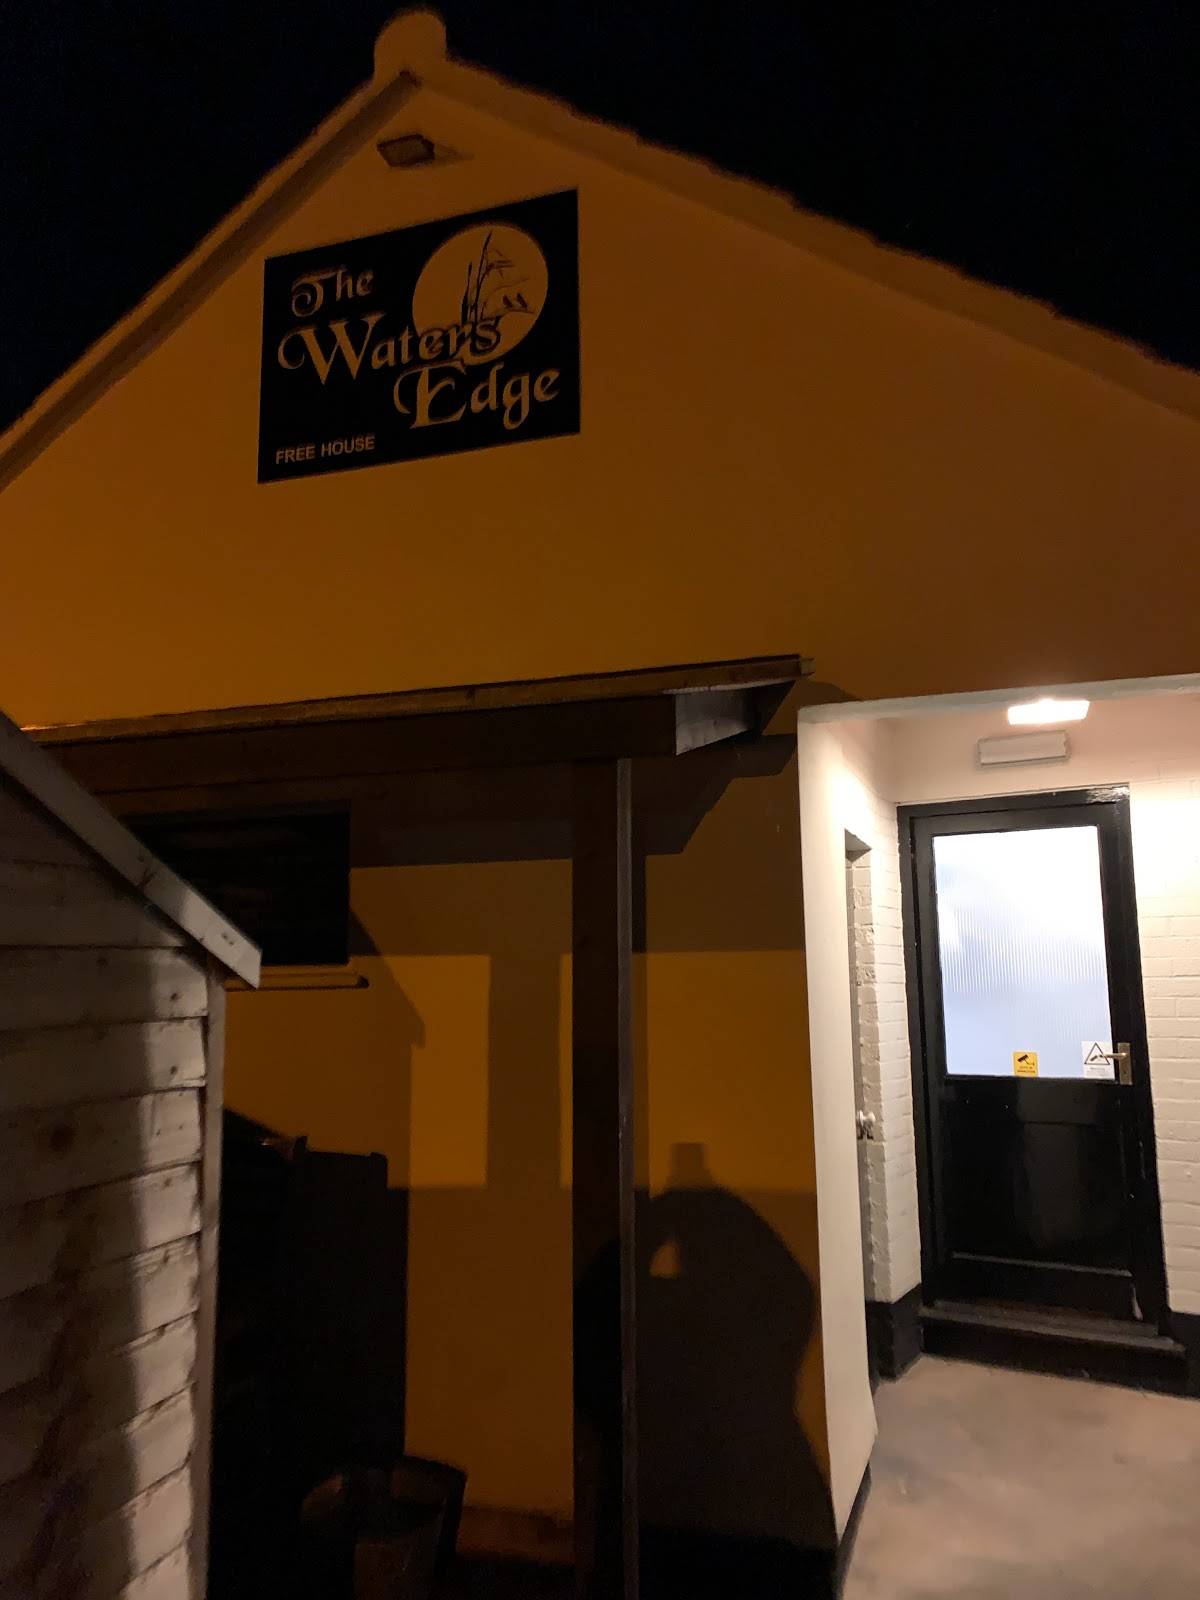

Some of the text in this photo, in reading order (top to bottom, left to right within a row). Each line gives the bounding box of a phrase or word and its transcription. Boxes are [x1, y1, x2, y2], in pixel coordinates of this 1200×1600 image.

[291, 265, 374, 318] The
[277, 313, 501, 385] Waters
[393, 361, 560, 430] Edge
[275, 435, 376, 464] FREE HOUSE
